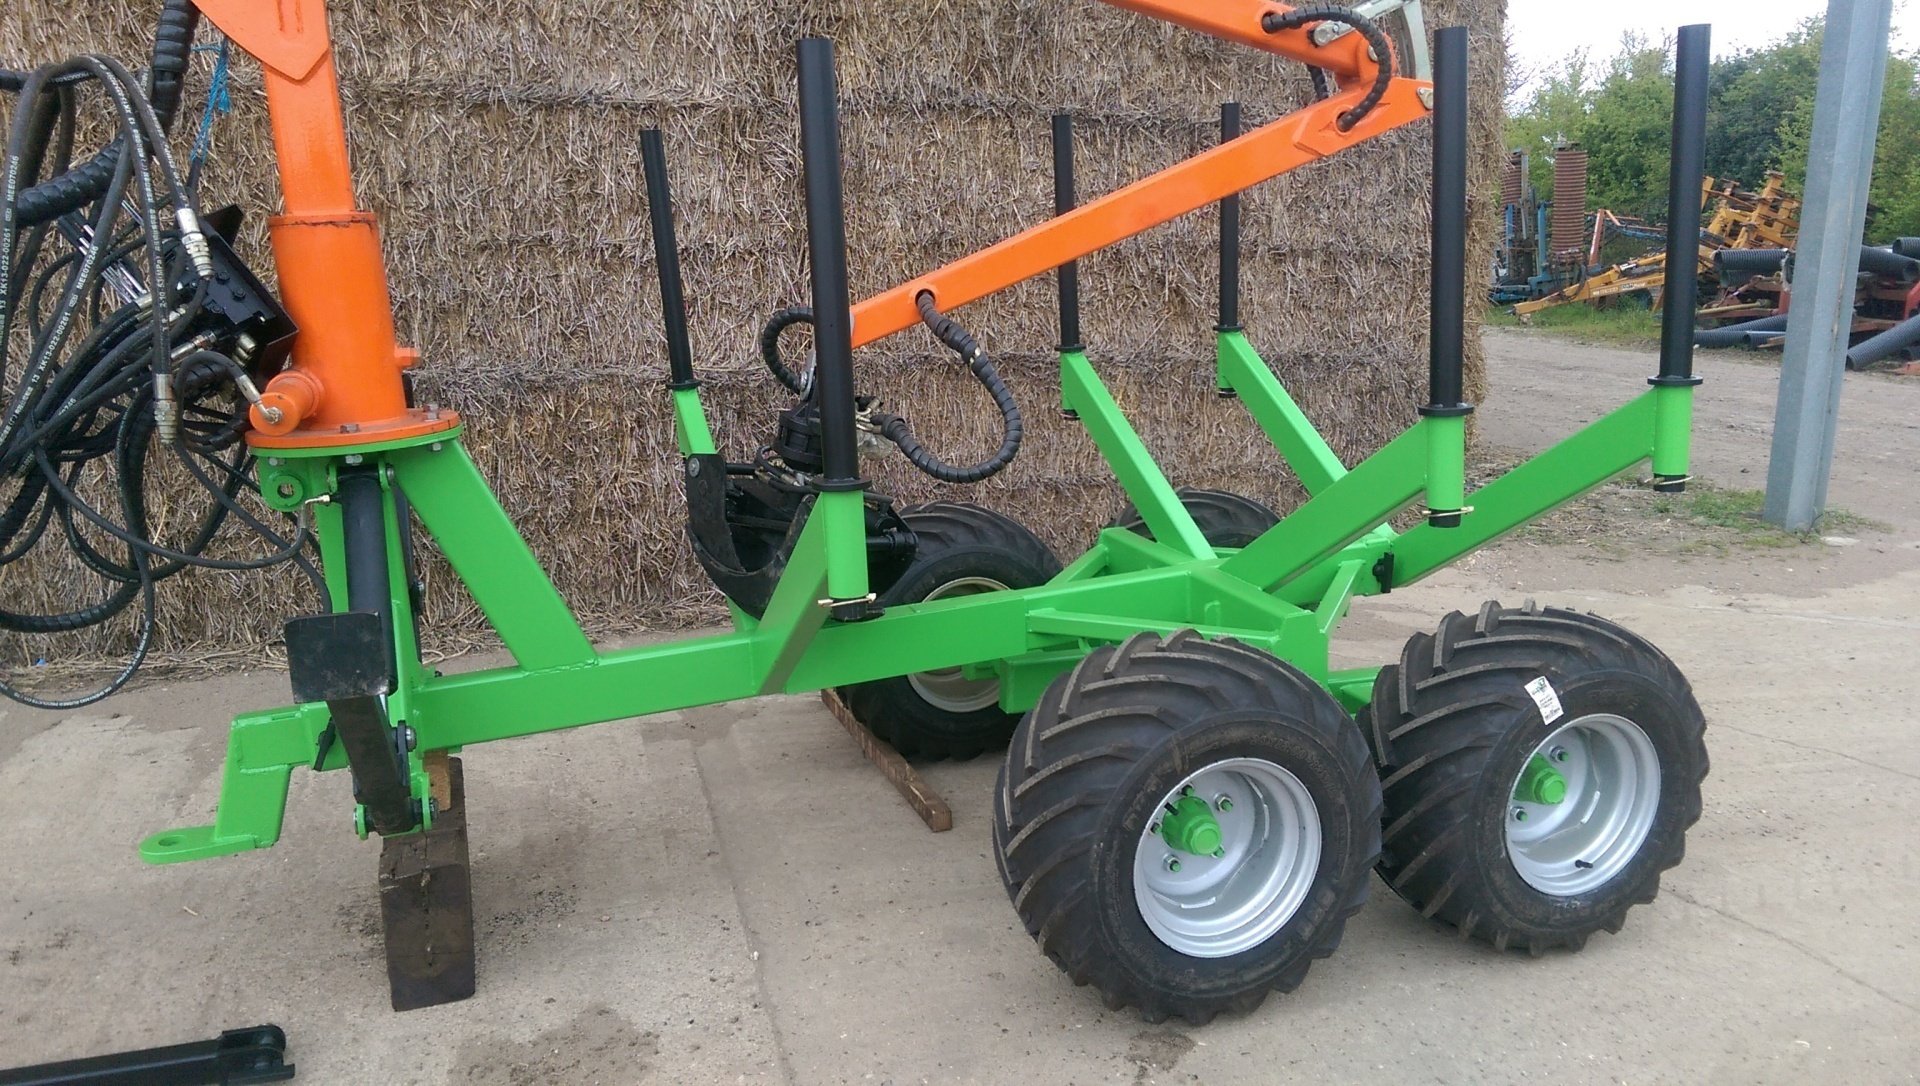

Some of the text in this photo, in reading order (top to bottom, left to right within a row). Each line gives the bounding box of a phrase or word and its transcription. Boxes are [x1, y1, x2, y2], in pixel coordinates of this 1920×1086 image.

[7, 154, 20, 202] MEE070246
[37, 311, 71, 372] XK13-022-00261
[75, 245, 99, 290] MEE070246
